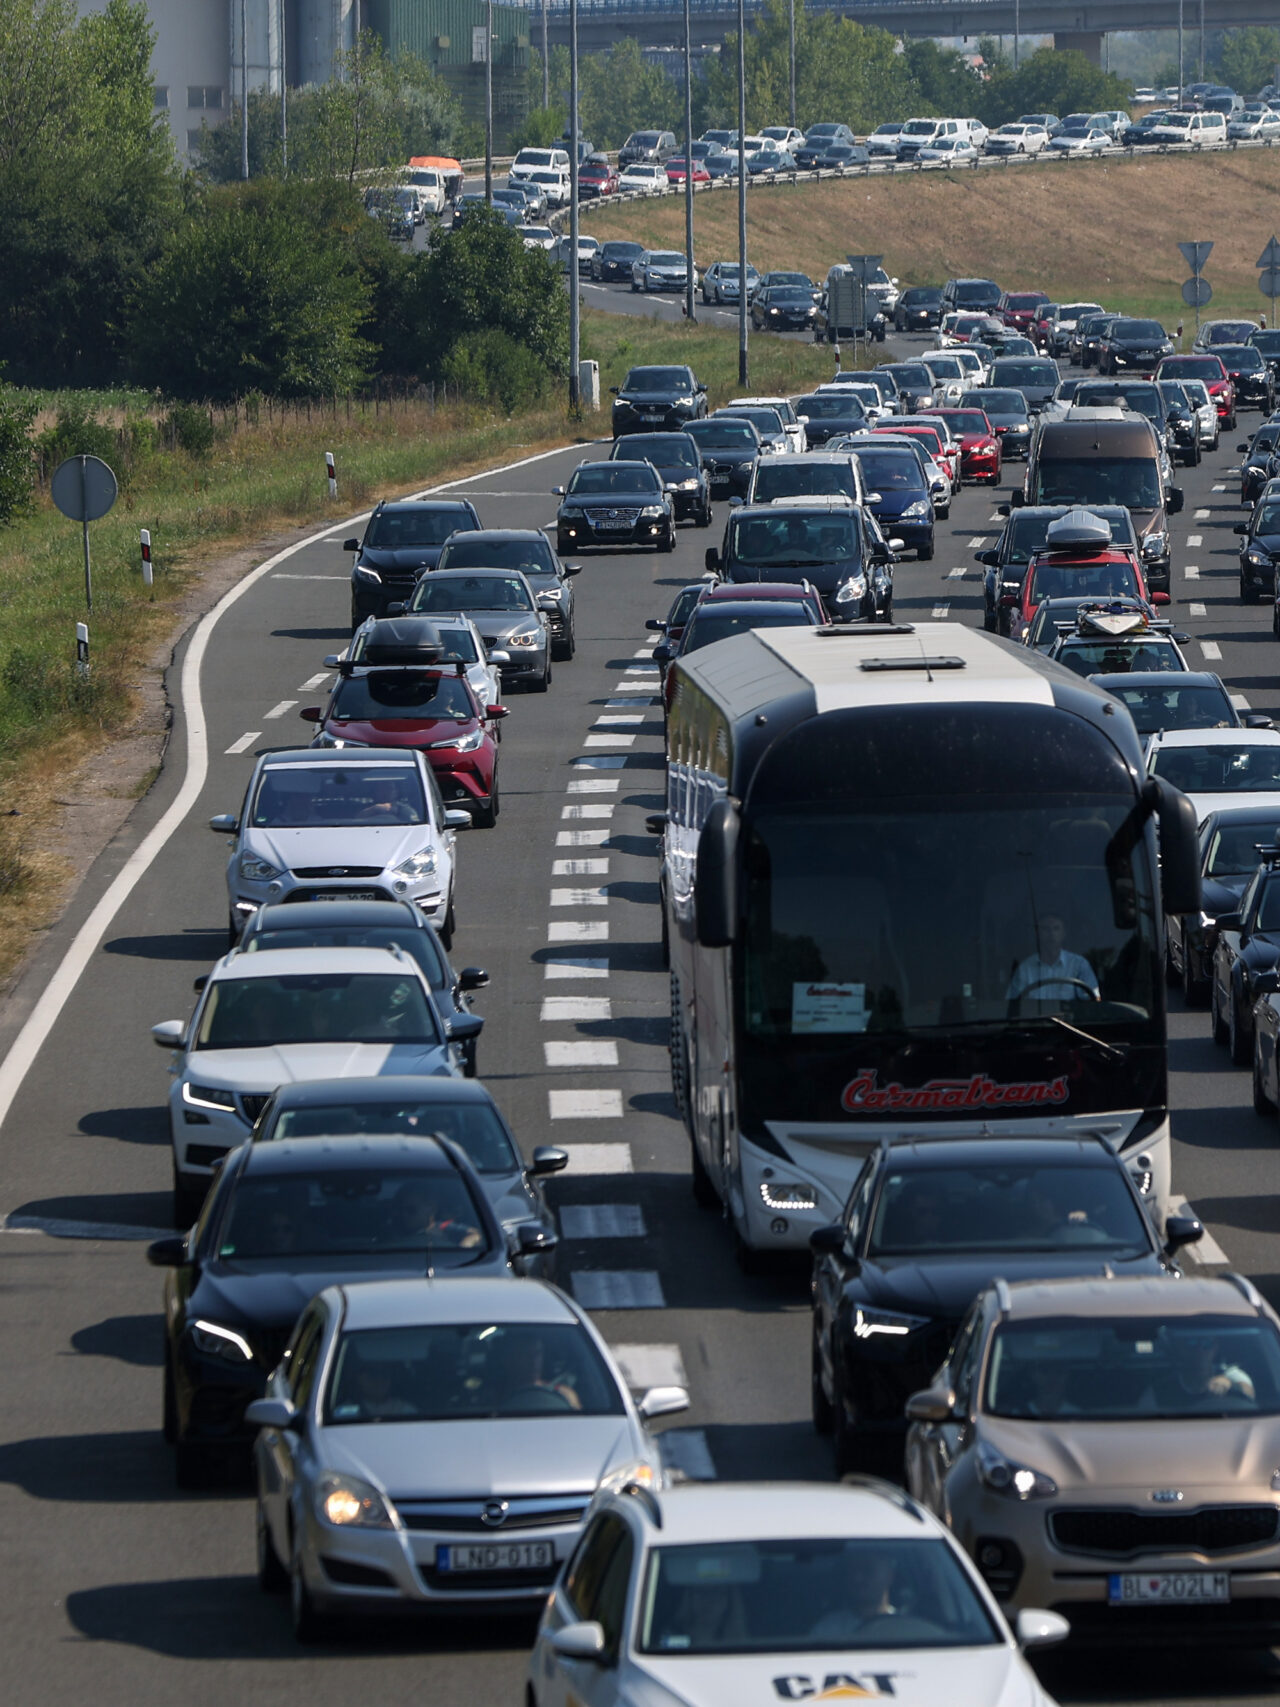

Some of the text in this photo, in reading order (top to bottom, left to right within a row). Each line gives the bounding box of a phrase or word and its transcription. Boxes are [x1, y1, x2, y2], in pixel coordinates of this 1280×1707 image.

[452, 1545, 547, 1569] LND-019
[1123, 1578, 1149, 1599] BL
[772, 1671, 897, 1701] CAT
